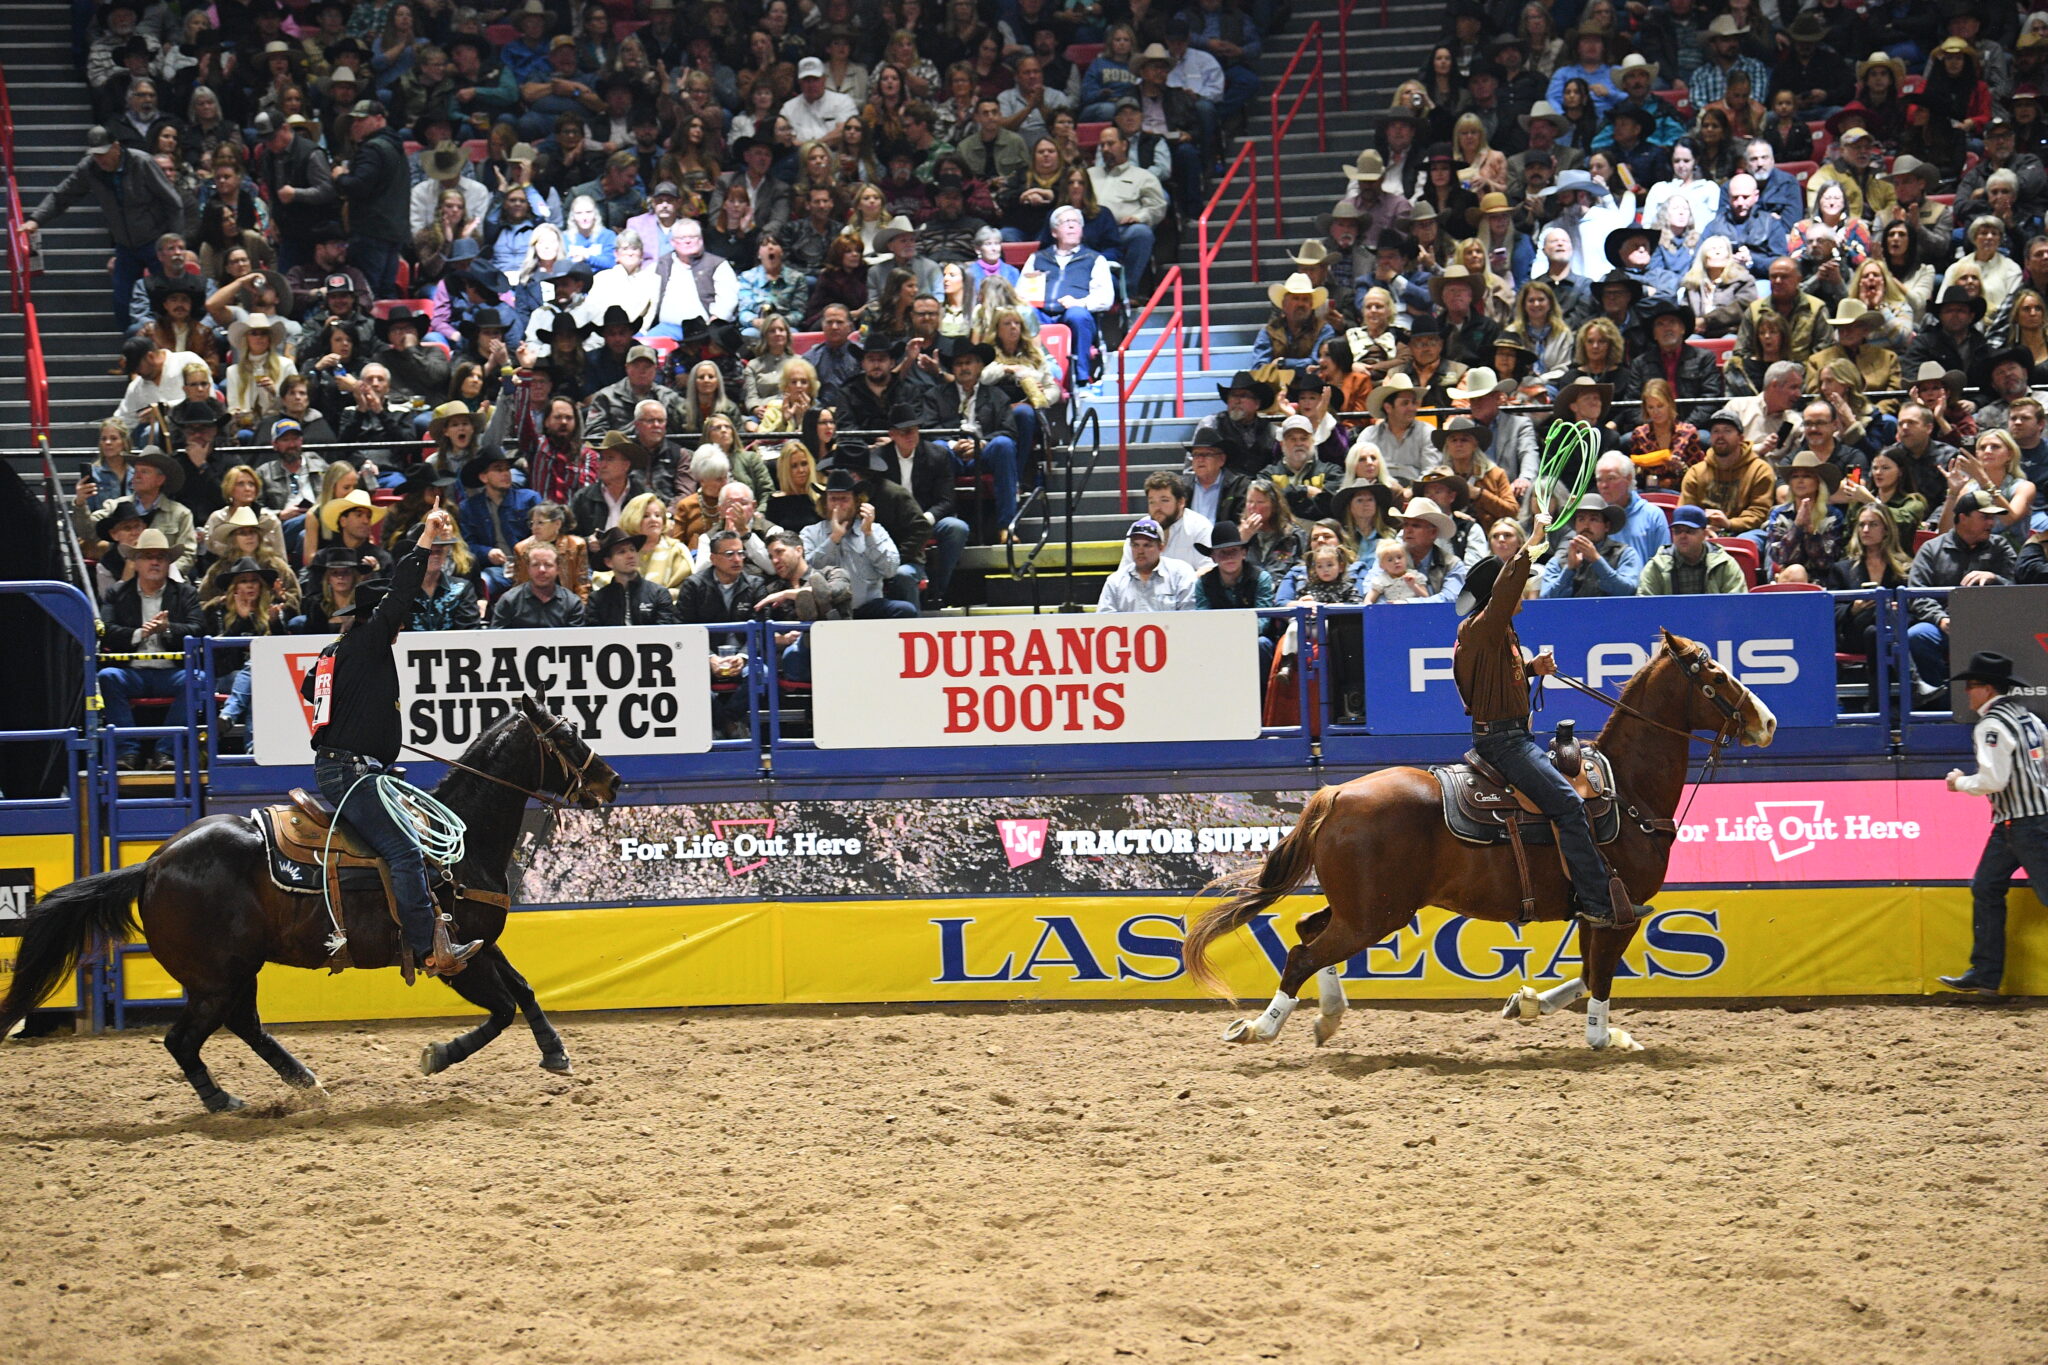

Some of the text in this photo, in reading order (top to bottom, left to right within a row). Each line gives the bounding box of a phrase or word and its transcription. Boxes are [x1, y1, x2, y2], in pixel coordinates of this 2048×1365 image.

[407, 643, 676, 694] TRACTOR
[899, 624, 1167, 678] DURANGO
[1409, 639, 1799, 693] PLAIS
[315, 673, 332, 689] FR
[2007, 686, 2048, 697] ASS
[409, 694, 607, 745] SUPLY
[942, 682, 1126, 733] BOOTS
[620, 832, 861, 861] For Life Out Here
[1001, 820, 1041, 859] TSC
[1057, 828, 1194, 856] TRACTOR
[1673, 815, 1920, 842] or Life Out Here
[928, 914, 1187, 983] LAS
